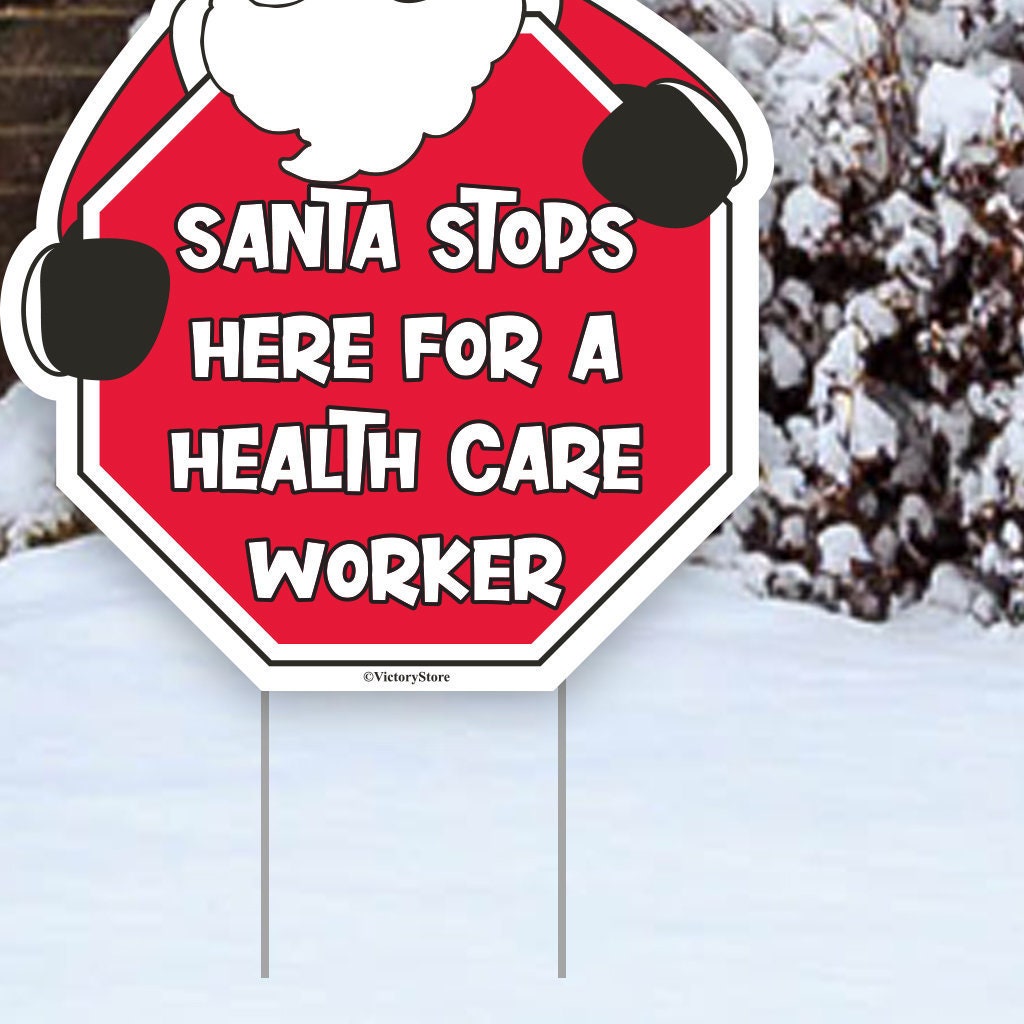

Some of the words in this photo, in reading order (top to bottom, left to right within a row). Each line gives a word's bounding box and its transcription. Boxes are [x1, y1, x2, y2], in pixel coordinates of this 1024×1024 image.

[175, 184, 399, 273] SANTA
[427, 184, 637, 273] STOPS
[189, 312, 373, 387] HERE
[400, 312, 542, 387] FOR
[569, 311, 622, 383] A
[168, 406, 420, 495] HEALTH
[447, 420, 644, 499] CARE
[245, 533, 566, 609] WORKER
